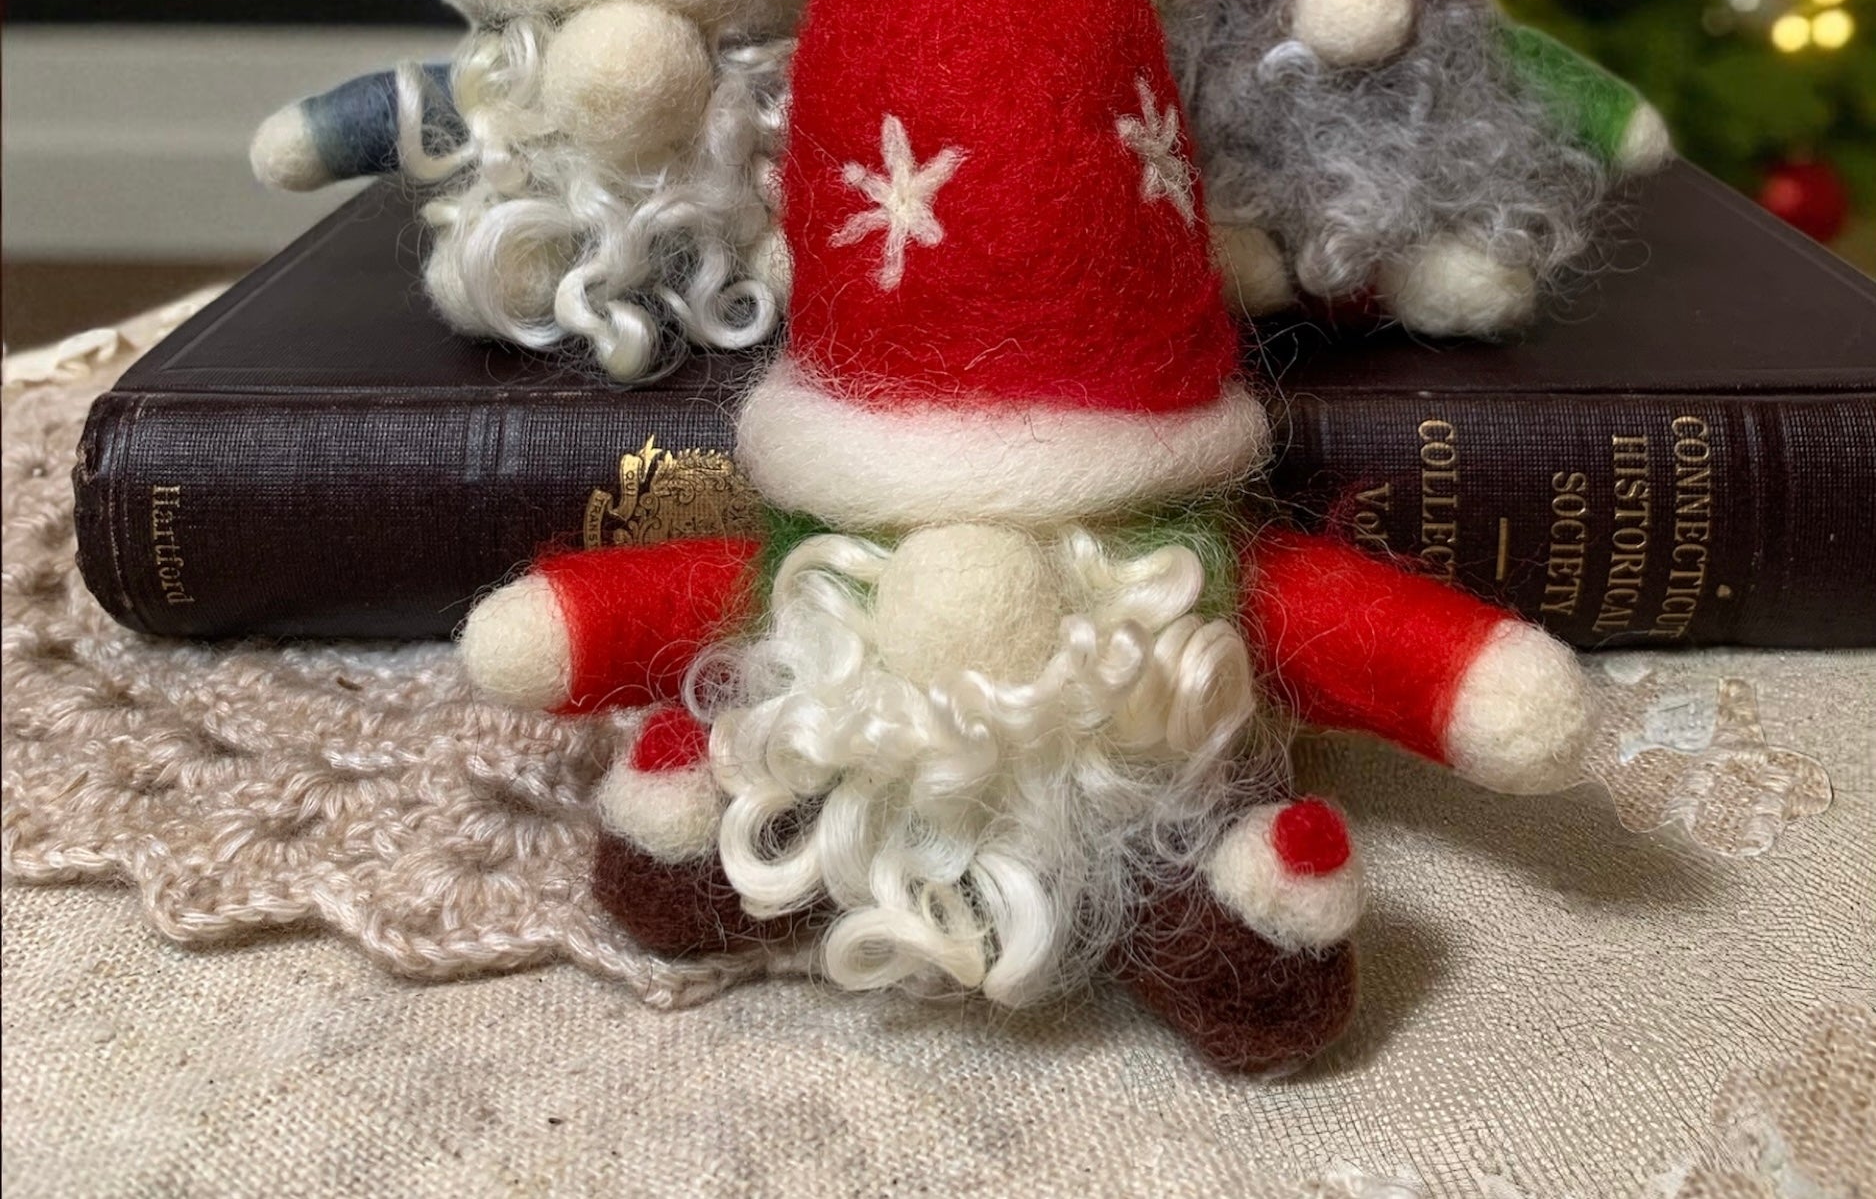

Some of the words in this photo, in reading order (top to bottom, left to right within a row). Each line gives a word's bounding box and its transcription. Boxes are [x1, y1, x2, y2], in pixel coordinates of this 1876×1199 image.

[152, 484, 196, 605] Hartford
[625, 470, 636, 497] QUI
[1539, 471, 1588, 616] SOCIETY
[1592, 433, 1650, 633] HISTORICAL
[1649, 416, 1711, 639] CONNECTICUT
